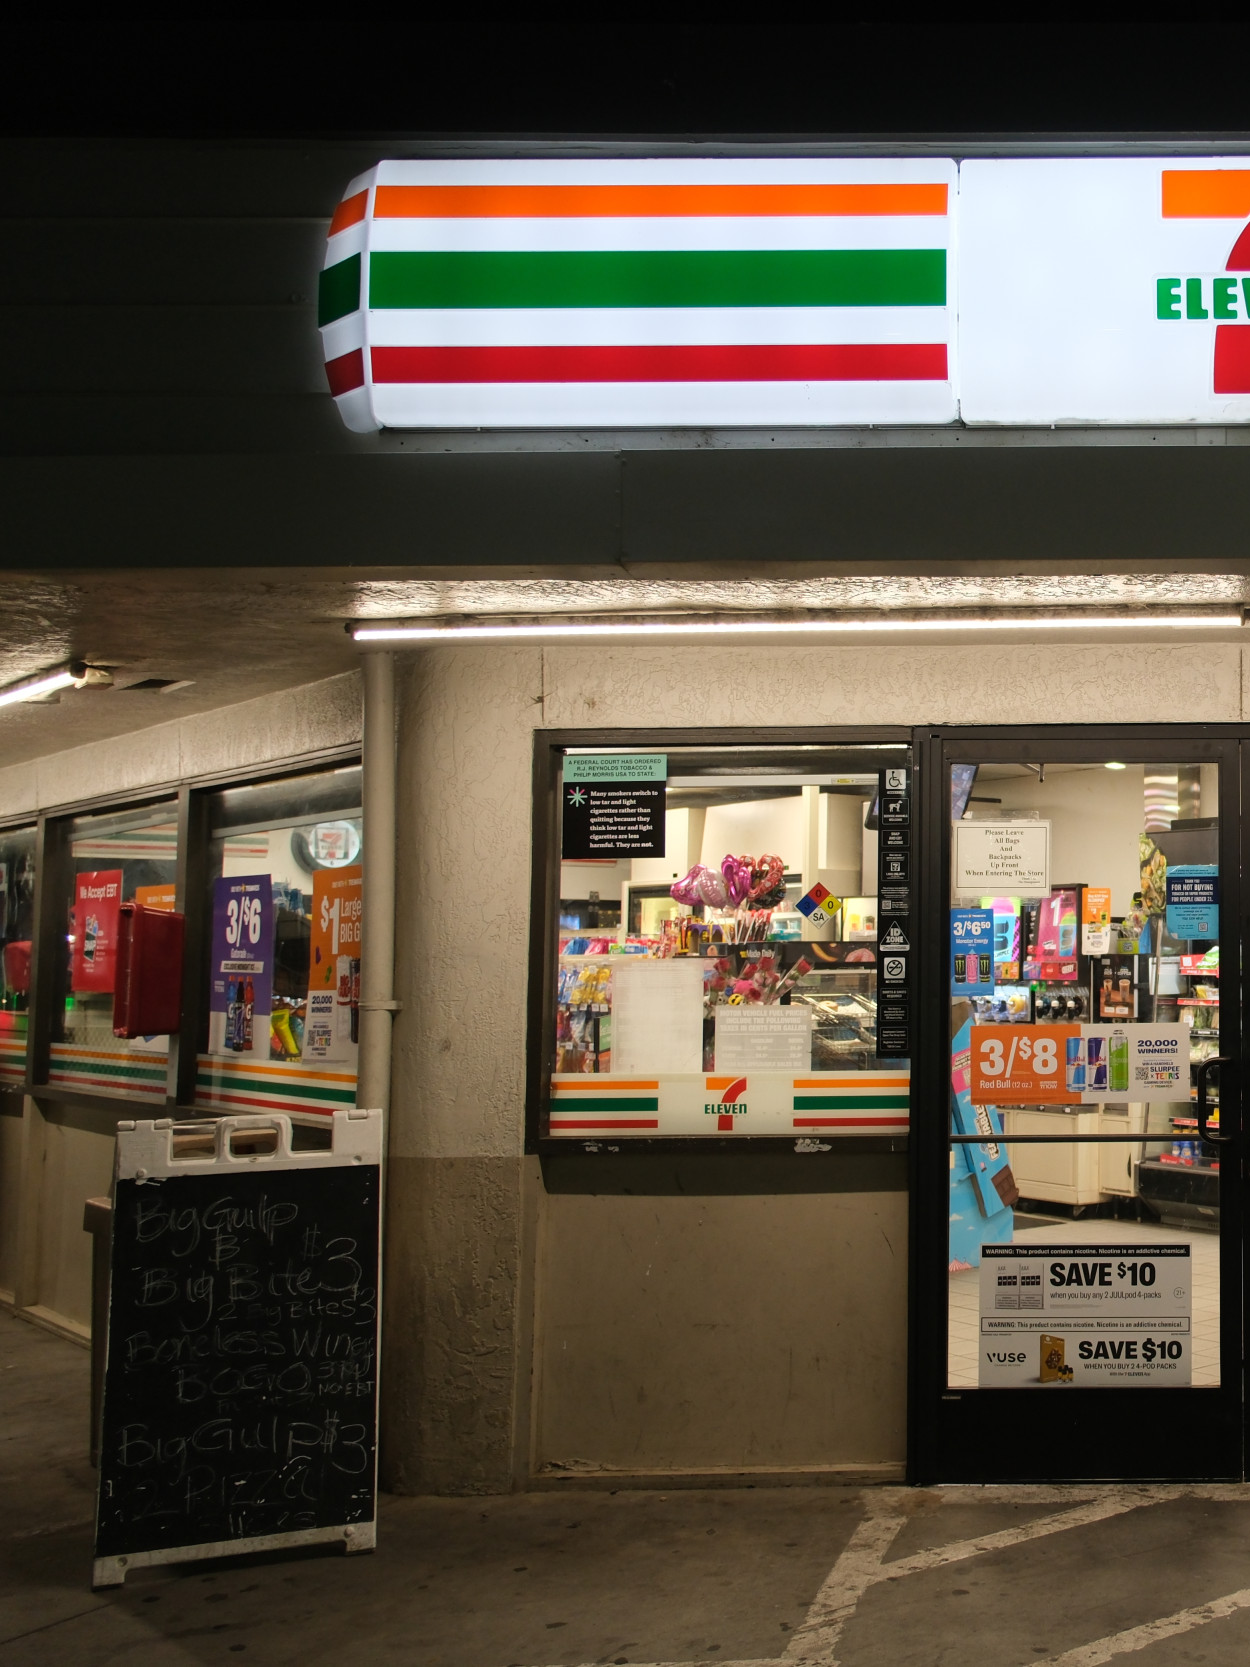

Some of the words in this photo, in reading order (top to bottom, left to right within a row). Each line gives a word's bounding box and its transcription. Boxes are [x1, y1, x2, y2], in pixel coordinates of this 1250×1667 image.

[88, 886, 105, 898] Accept
[816, 889, 821, 897] 0
[828, 901, 834, 909] 0
[813, 913, 824, 921] SA
[890, 928, 900, 936] ID
[1138, 1040, 1178, 1048] 20,000
[979, 1036, 1058, 1078] 3/$8
[980, 1080, 994, 1088] Red
[997, 1080, 1010, 1088] Bull
[706, 1077, 747, 1131] 7
[135, 1197, 201, 1257] Big
[202, 1193, 298, 1246] Gulp
[1050, 1262, 1112, 1286] SAVE
[1117, 1261, 1156, 1286] $10
[135, 1265, 214, 1332] Big
[1068, 1293, 1079, 1301] you
[1080, 1291, 1091, 1301] buy
[1092, 1293, 1103, 1301] any
[1137, 1291, 1161, 1301] 4-packs
[1078, 1340, 1137, 1360] SAVE
[1142, 1338, 1182, 1362] $10
